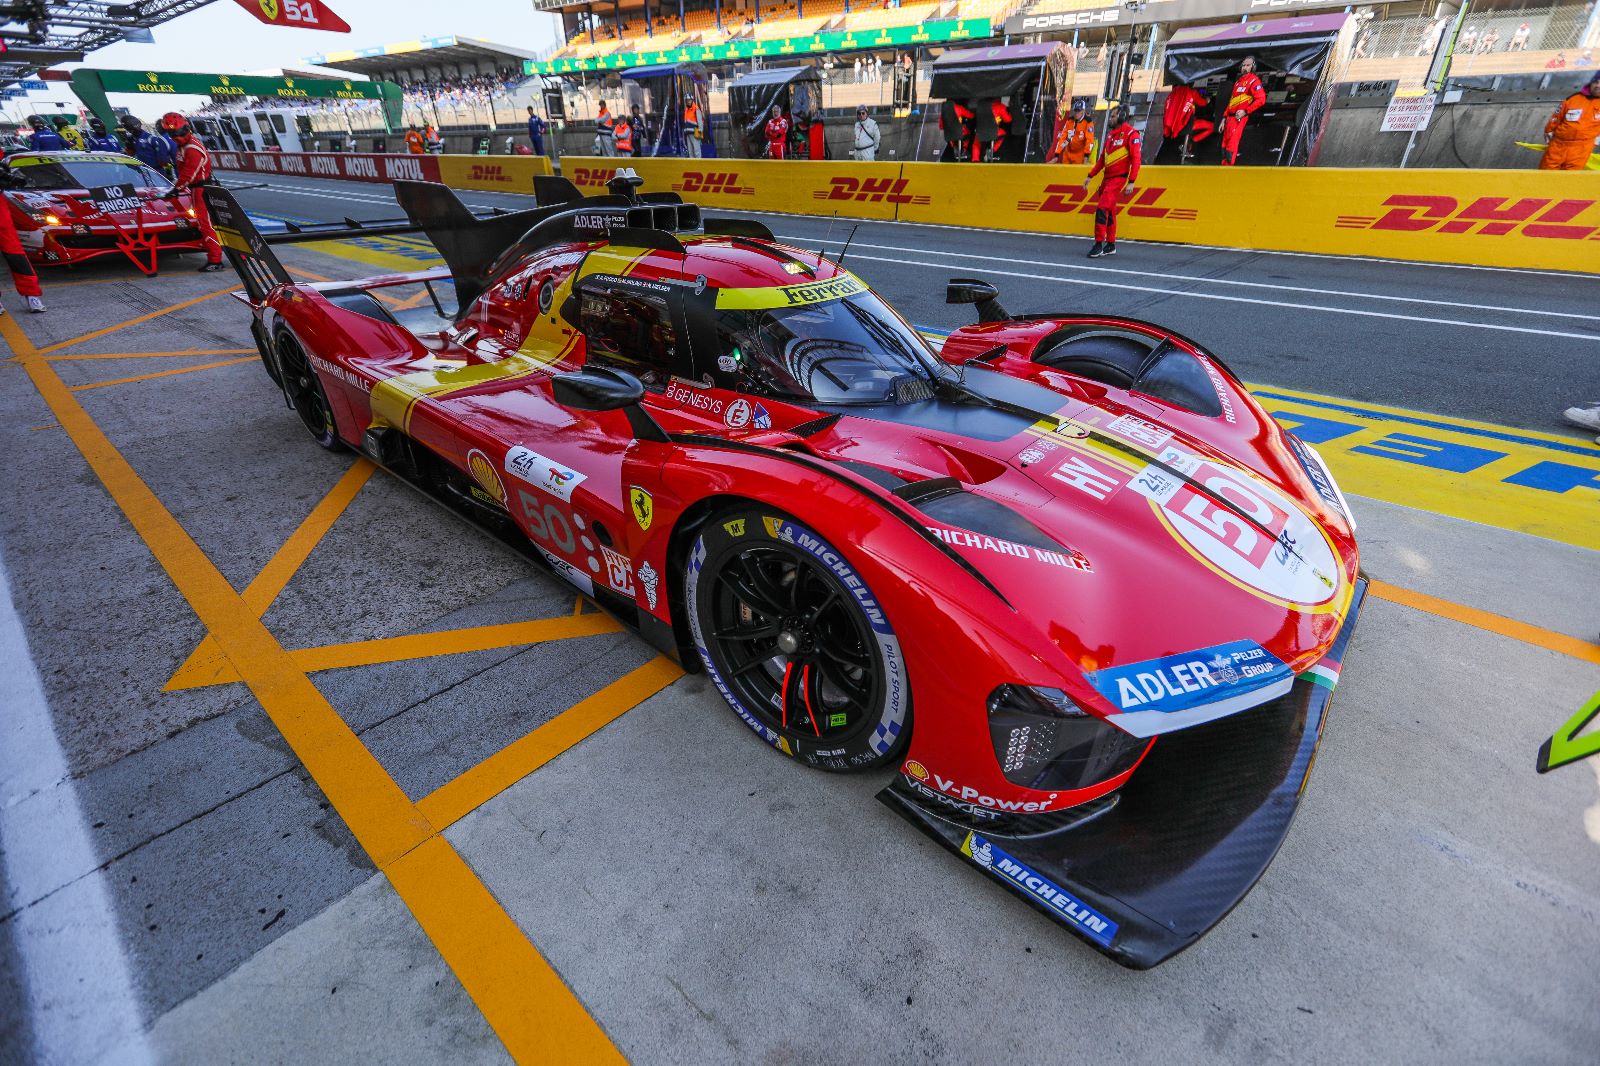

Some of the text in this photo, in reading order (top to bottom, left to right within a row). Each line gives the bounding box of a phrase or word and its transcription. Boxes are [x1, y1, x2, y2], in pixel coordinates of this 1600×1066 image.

[283, 0, 319, 24] 51
[1022, 9, 1120, 30] PORSCHE
[137, 83, 176, 93] ROLEX
[211, 86, 245, 95] ROLEX
[277, 88, 308, 97] ROLEX
[336, 90, 365, 98] ROLEX
[1393, 96, 1433, 105] INTERDICTIN
[253, 155, 276, 171] MOTUL
[280, 156, 306, 173] MOTUL
[310, 156, 340, 175] MOTUL
[345, 157, 378, 177] MOTUL
[384, 158, 424, 180] MOTUL
[471, 165, 506, 181] DHL
[682, 171, 742, 194] DHL
[828, 176, 912, 204] DHL
[97, 197, 142, 213] ENGINE
[1369, 194, 1600, 239] DHL
[574, 215, 603, 229] ADLER
[309, 354, 372, 394] RICHARD MILLE
[674, 388, 723, 414] GENESYS
[1051, 456, 1121, 500] HY
[517, 488, 576, 555] 50
[1181, 475, 1276, 561] 50
[925, 527, 1095, 574] RICHARD MILLE
[545, 553, 574, 576] WEC
[797, 533, 886, 626] MICHELIN
[1230, 648, 1266, 664] PELZER
[884, 643, 900, 713] PILOT SPORT
[1241, 662, 1274, 678] GROUP
[700, 653, 763, 733] MICHELIN
[1114, 660, 1219, 709] ADLER
[904, 774, 1001, 820] VISTAJET
[933, 773, 1053, 812] V-Power
[996, 857, 1109, 934] MICHELIN
